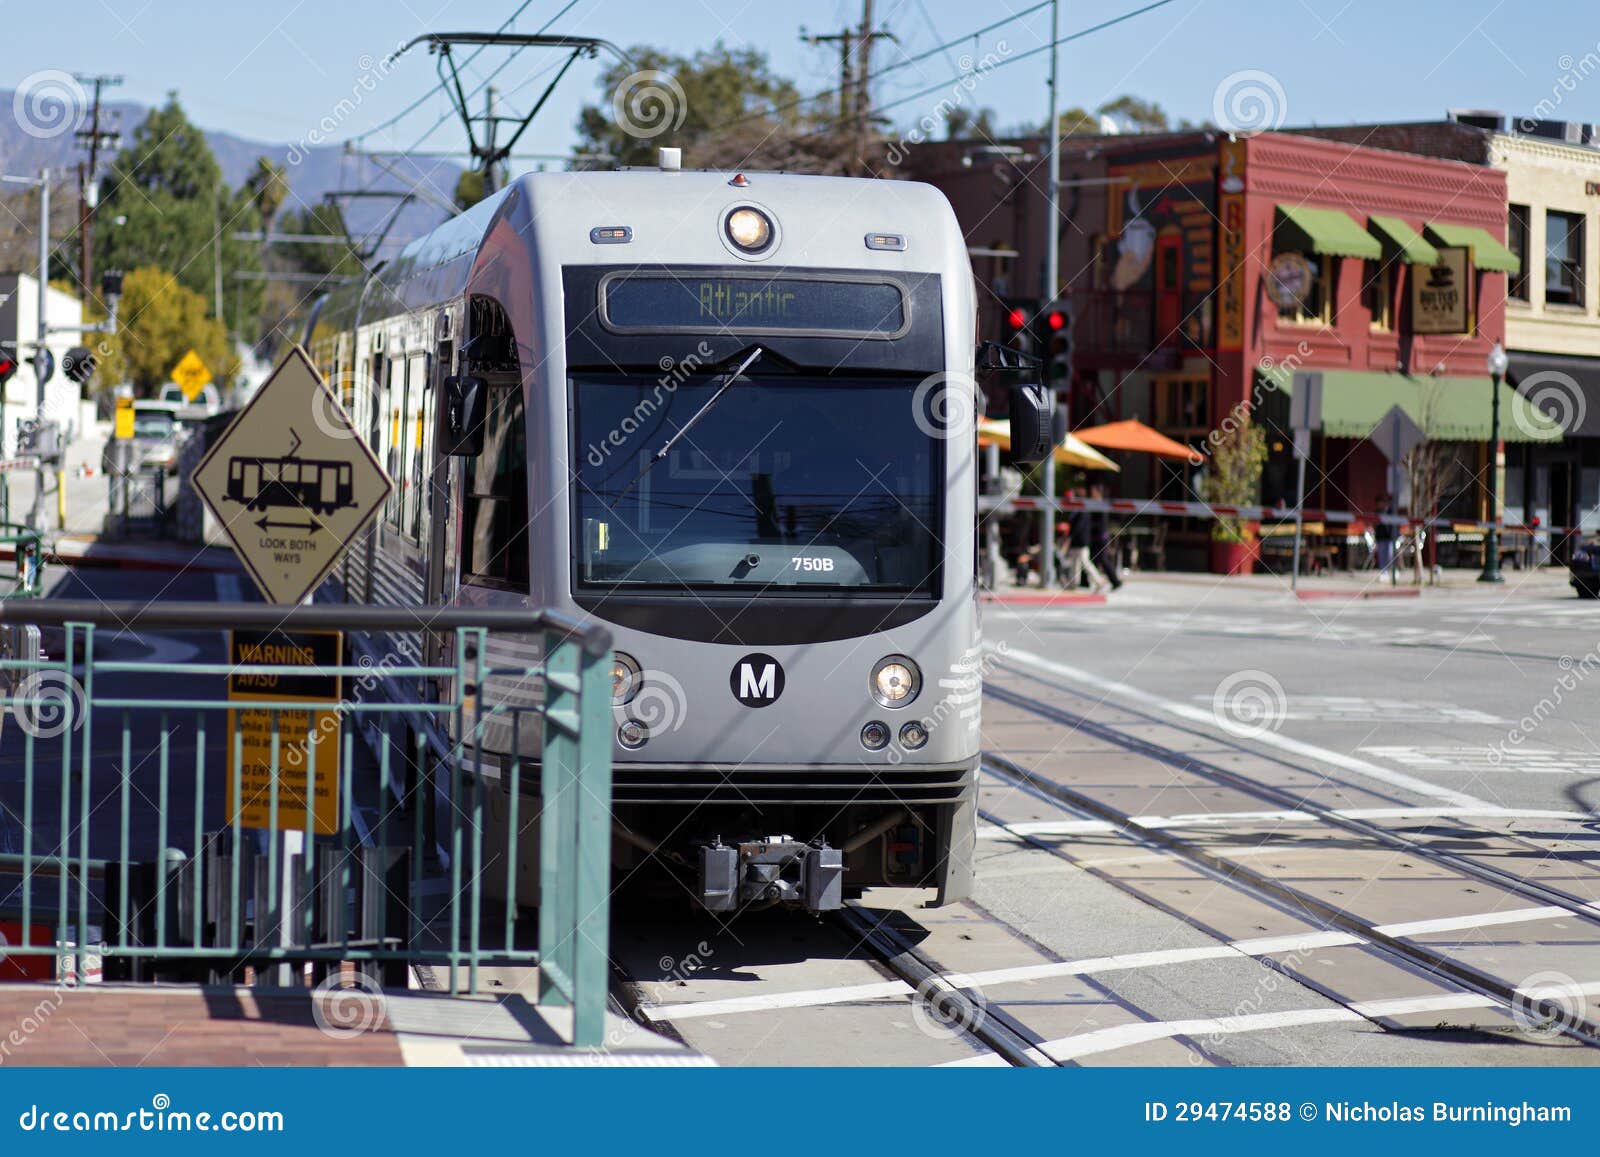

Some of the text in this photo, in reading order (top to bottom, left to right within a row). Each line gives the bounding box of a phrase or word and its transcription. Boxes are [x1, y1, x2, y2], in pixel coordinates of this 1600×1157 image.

[259, 538, 317, 551] LOOK BOTH
[274, 552, 302, 564] WAYS
[792, 558, 834, 571] 750B
[238, 643, 315, 665] WARNING
